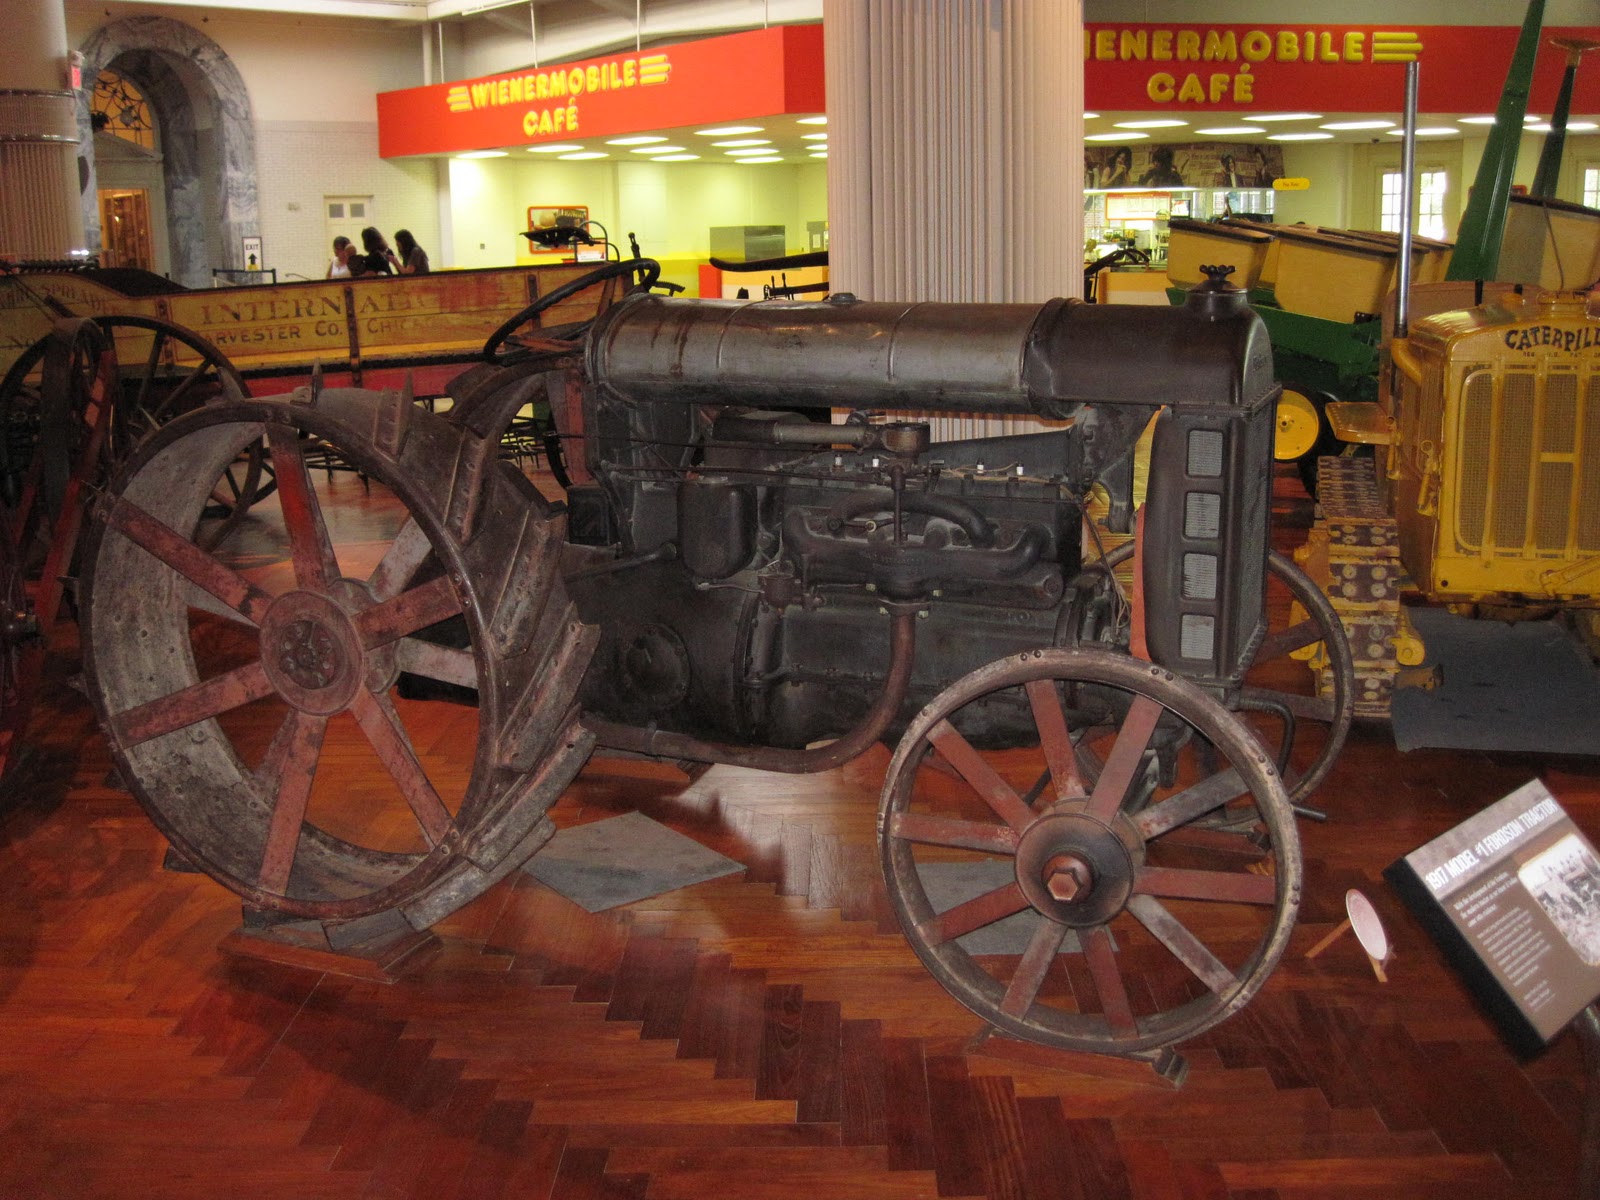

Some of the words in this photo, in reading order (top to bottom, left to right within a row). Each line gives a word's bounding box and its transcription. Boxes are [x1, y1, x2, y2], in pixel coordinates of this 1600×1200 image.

[1084, 29, 1366, 63] IENERMOBILE
[471, 59, 637, 110] WIENERMOBILE
[1146, 62, 1255, 104] CAFÉ
[522, 96, 579, 137] CAFÉ
[245, 243, 259, 251] EXIT
[1518, 797, 1558, 833] TRACTOR
[1475, 844, 1490, 857] #1
[1482, 819, 1525, 854] FORDSON
[1425, 868, 1448, 890] 1917
[1444, 848, 1480, 879] MODEL
